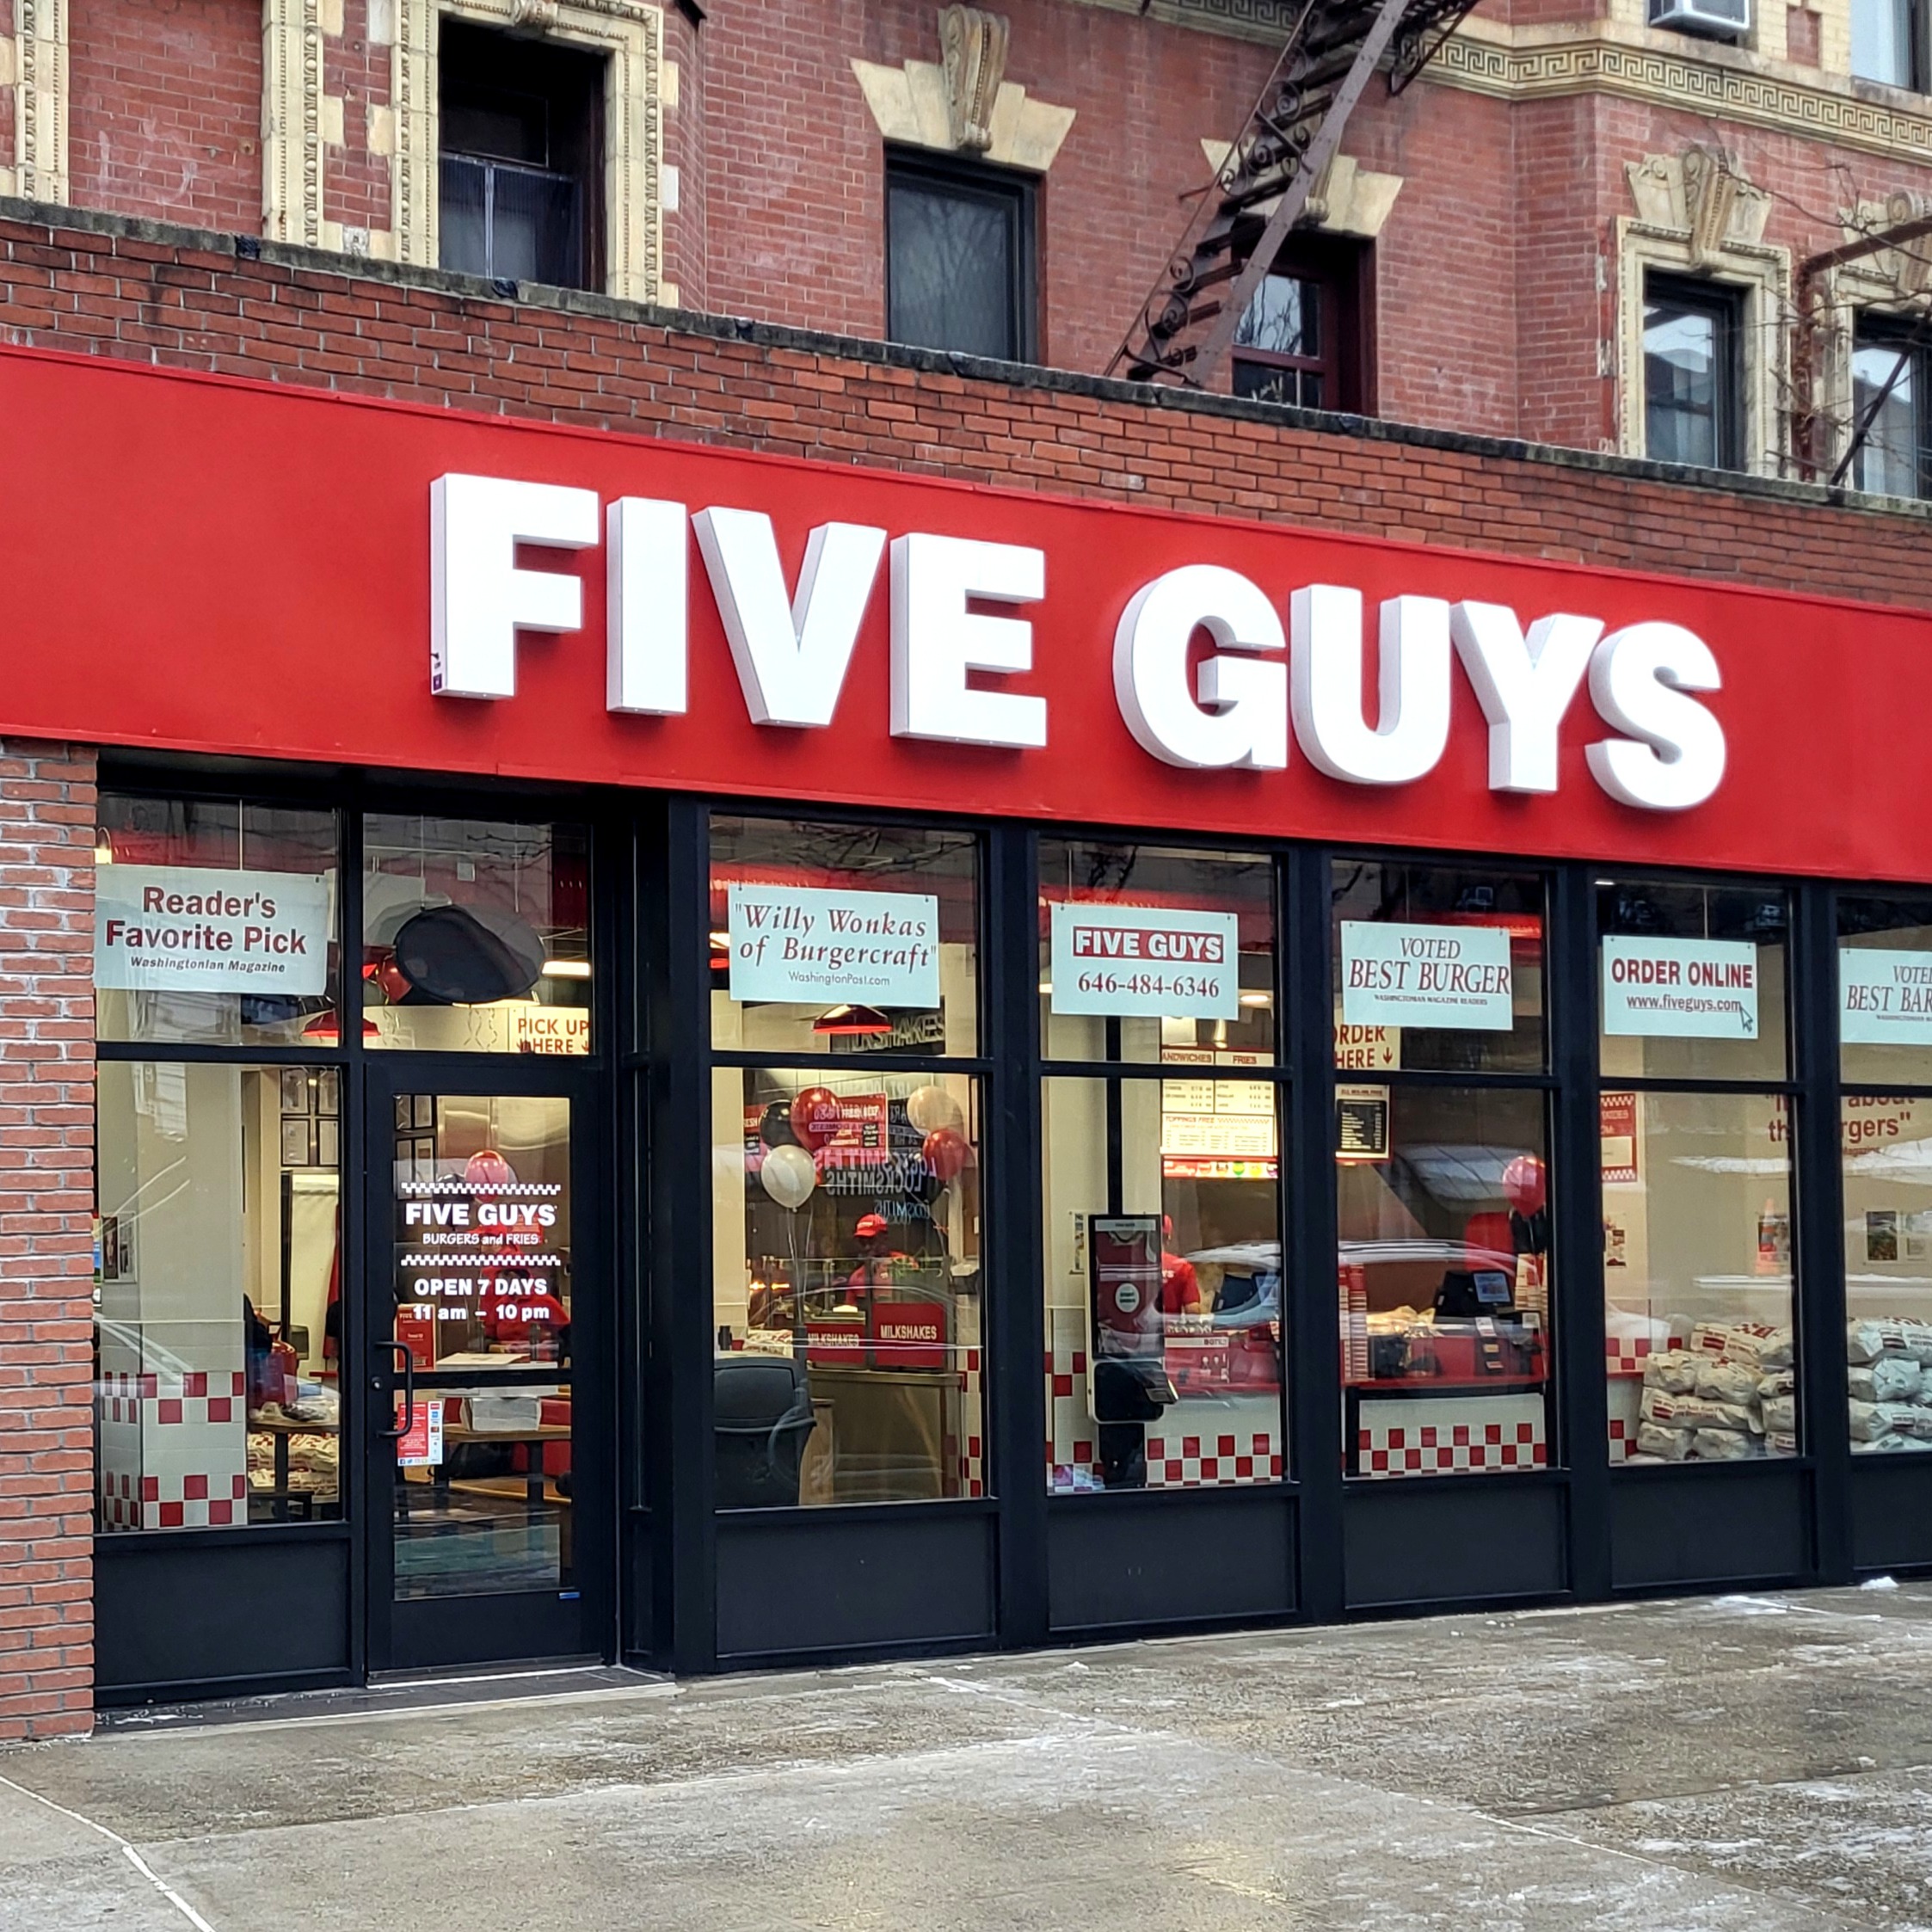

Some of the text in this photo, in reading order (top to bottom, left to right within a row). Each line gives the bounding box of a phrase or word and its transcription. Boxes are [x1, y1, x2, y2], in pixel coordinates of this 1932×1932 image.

[430, 473, 1727, 810] FIVE GUYS
[143, 886, 277, 919] Reader's
[735, 903, 927, 938] "Willy Wonkas
[106, 920, 306, 955] Favorite Pick
[1075, 930, 1222, 961] FIVE GUYS
[740, 935, 937, 974] of Burgercraft"
[1400, 938, 1461, 960] VOTED
[130, 956, 286, 974] Washingtonian Magazine
[1612, 957, 1753, 989] ORDER ONLINE
[1893, 965, 1932, 984] VOTE
[788, 971, 891, 986] WashingtonPost.com
[1078, 971, 1220, 998] 646-484-6346
[1348, 958, 1511, 994] BEST BURGER
[1627, 994, 1742, 1013] www.fiveguys.com
[1846, 985, 1894, 1012] BEST
[518, 1018, 591, 1036] PICK UP
[533, 1037, 574, 1054] HERE
[1162, 1052, 1212, 1063] ANDWICHES
[1233, 1055, 1258, 1065] FRIES
[1334, 1048, 1375, 1069] HERE
[405, 1203, 470, 1226] FIVE
[477, 1203, 557, 1227] GUYS
[422, 1233, 539, 1245] BURGERS and FRIES
[414, 1278, 548, 1296] OPEN 7 DAYS
[413, 1304, 432, 1320] 11
[438, 1307, 467, 1320] am
[495, 1304, 518, 1320] 10
[521, 1307, 550, 1322] pm
[807, 1332, 859, 1347] MILKSHAKES
[880, 1325, 938, 1340] MILKSHAKES
